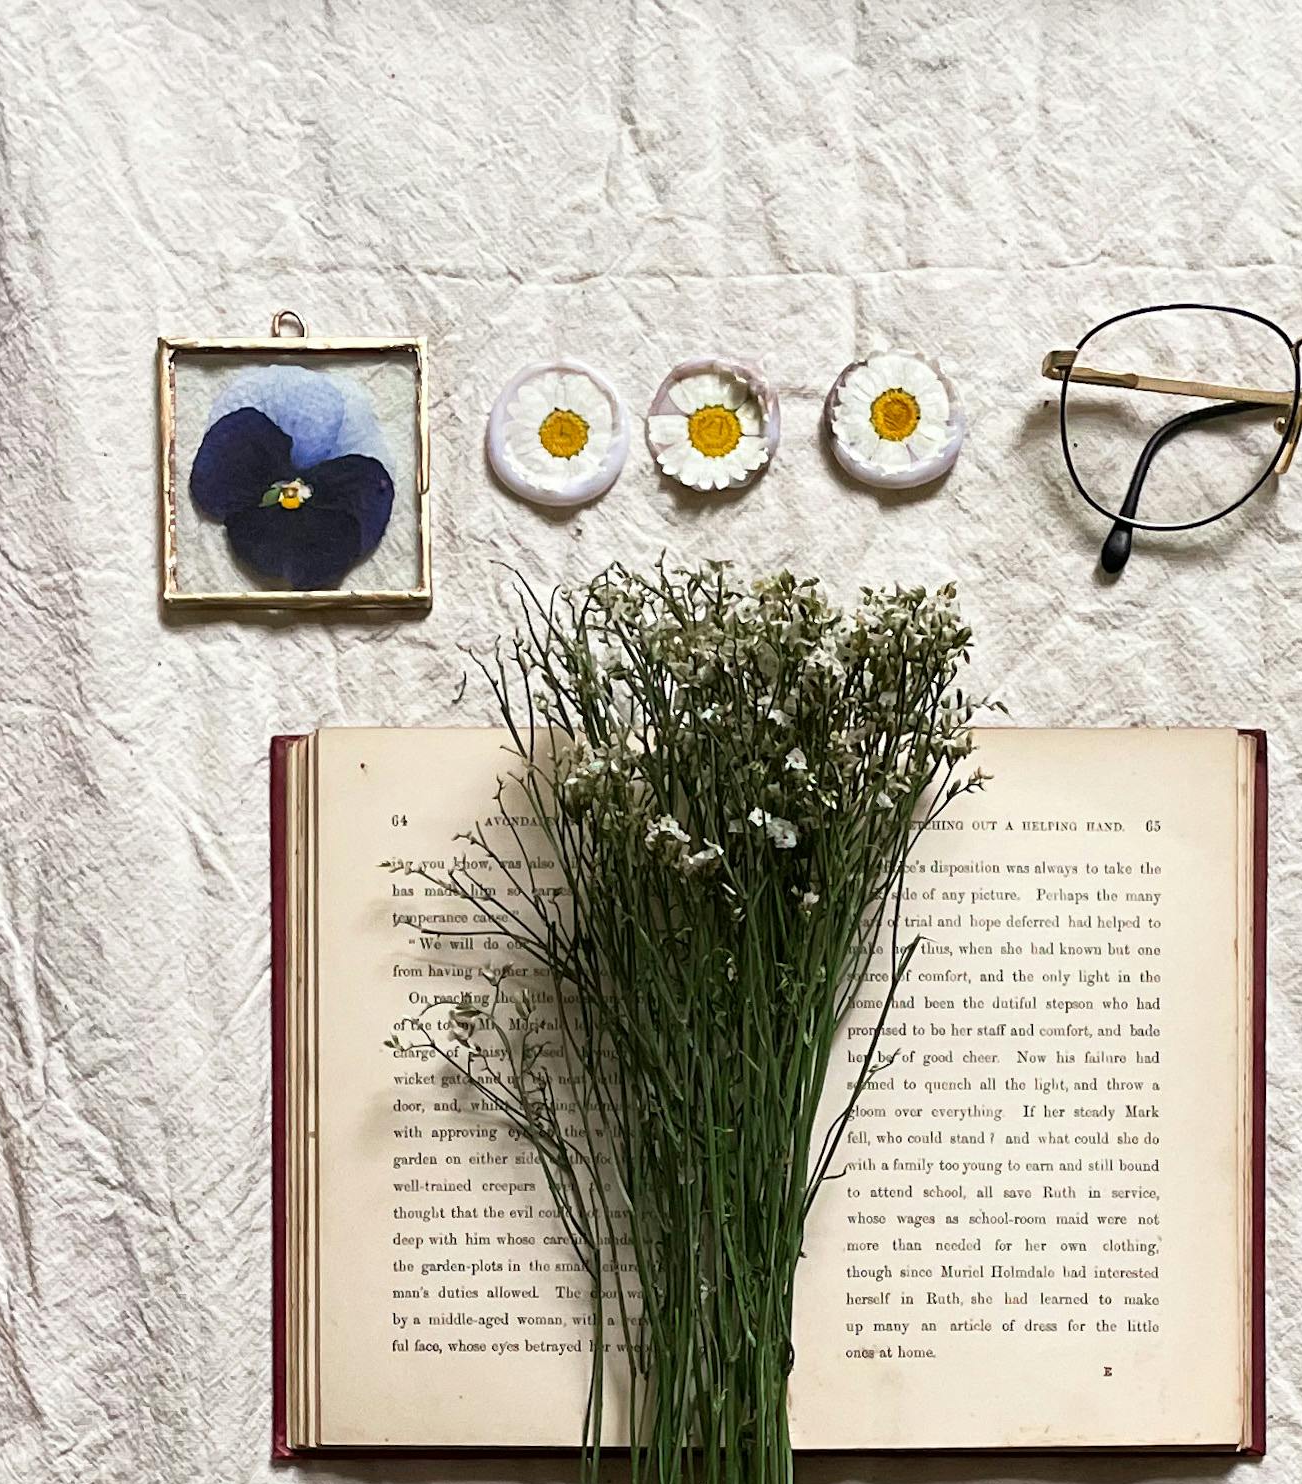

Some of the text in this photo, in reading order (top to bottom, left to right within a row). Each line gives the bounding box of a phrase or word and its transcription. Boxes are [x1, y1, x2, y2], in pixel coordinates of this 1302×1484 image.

[391, 813, 408, 827] 64
[971, 820, 998, 832] OUT
[1004, 820, 1015, 831] A
[1021, 820, 1078, 832] HELPING
[1145, 818, 1162, 833] 65
[930, 859, 1162, 879] disposition was always to take the
[391, 884, 414, 897] has
[921, 887, 1162, 907] of any picture. Perhaps the many
[450, 937, 475, 949] will
[483, 937, 500, 950] do
[392, 964, 473, 980] from having
[923, 995, 1161, 1015] been the dutiful stepson who had
[393, 1072, 435, 1085] wicket
[393, 1098, 426, 1114] door,
[893, 1107, 924, 1118] over
[1022, 1103, 1037, 1118] If
[1042, 1104, 1066, 1119] her
[1073, 1104, 1116, 1123] steady
[1124, 1103, 1160, 1119] Mark
[393, 1125, 499, 1142] with approving
[846, 1129, 872, 1147] fell,
[875, 1130, 903, 1145] who
[907, 1130, 943, 1145] could
[1005, 1130, 1030, 1145] and
[1036, 1130, 1071, 1145] what
[1074, 1130, 1110, 1145] could
[1116, 1131, 1140, 1145] she
[1143, 1130, 1160, 1146] do
[393, 1152, 438, 1169] garden
[445, 1154, 462, 1165] on
[468, 1152, 508, 1166] either
[846, 1157, 1160, 1176] with a family too young to earn and still bound
[393, 1179, 537, 1196] well-trained creepers
[846, 1183, 1161, 1202] to attend school, all save Ruth in service,
[393, 1205, 534, 1223] thought that the evil
[846, 1210, 1161, 1229] whose wages as school-room maid were not
[393, 1232, 536, 1249] deep with him whose
[846, 1241, 880, 1252] more
[892, 1237, 923, 1252] than
[934, 1237, 982, 1252] needed
[994, 1238, 1014, 1252] for
[1024, 1237, 1048, 1252] her
[1059, 1242, 1088, 1253] own
[393, 1259, 550, 1277] the garden-plots in the
[845, 1264, 1160, 1283] though since Muriel Holmdale had interested
[392, 1286, 430, 1299] man's
[438, 1286, 479, 1299] duties
[555, 1286, 582, 1299] The
[845, 1291, 1160, 1307] herself in Ruth, she had learned to make
[392, 1312, 567, 1330] by a middle-aged woman,
[845, 1317, 1160, 1337] up many an article of dress for the little
[391, 1339, 582, 1357] ful face, whose eyes betrayed
[845, 1344, 937, 1360] ones at home.
[1102, 1365, 1113, 1378] E
